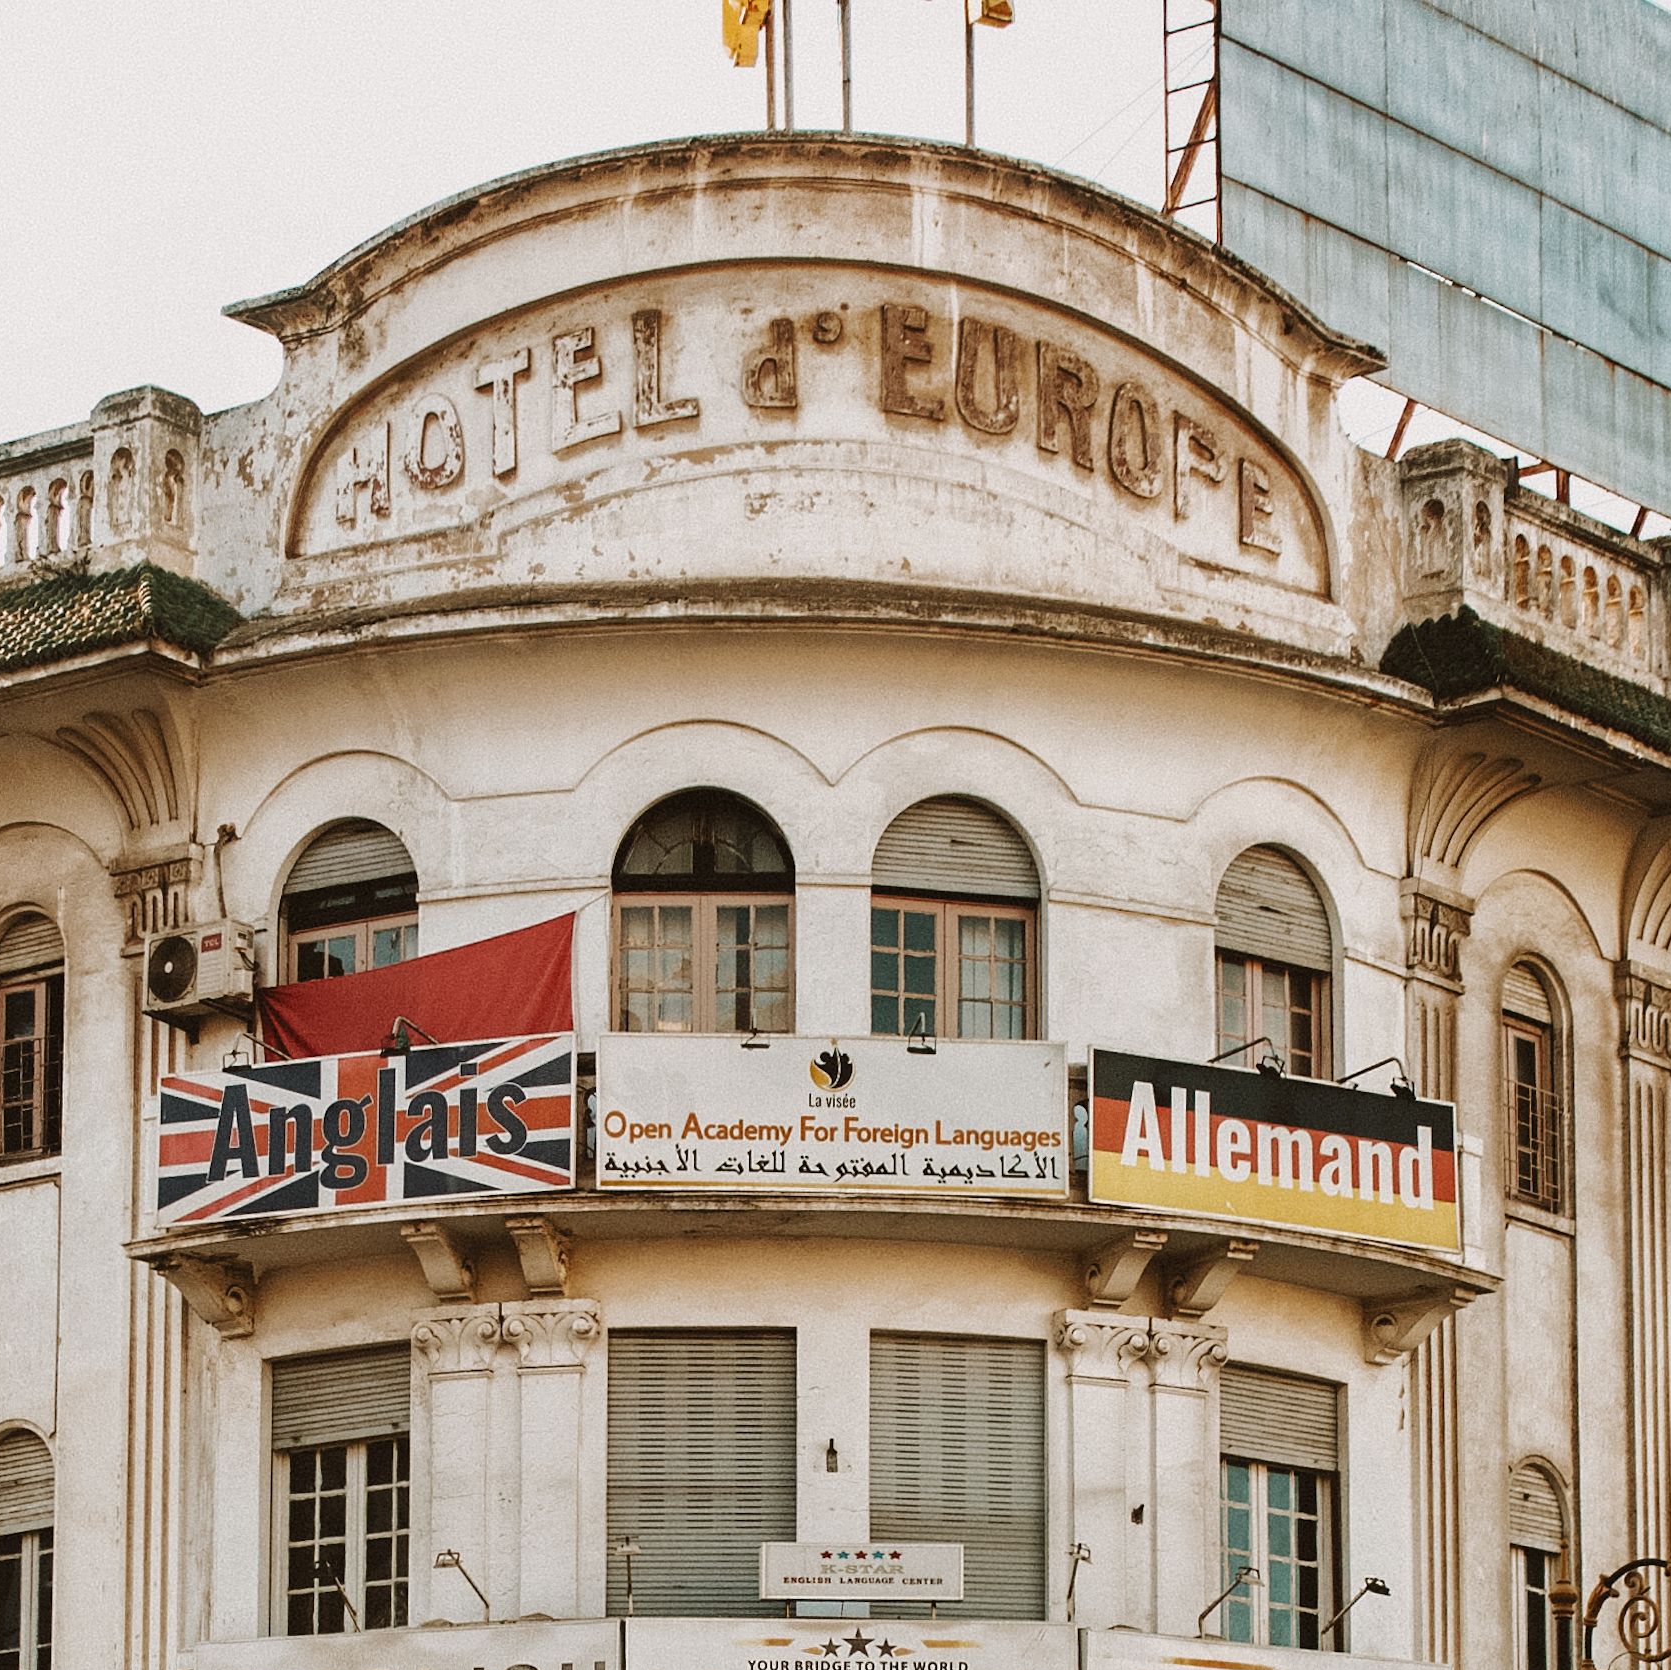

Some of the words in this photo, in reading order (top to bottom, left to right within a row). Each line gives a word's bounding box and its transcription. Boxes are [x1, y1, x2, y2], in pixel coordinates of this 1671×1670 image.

[334, 308, 700, 529] HOTEL
[808, 1093, 823, 1108] La
[825, 1092, 856, 1109] visée
[207, 1061, 529, 1190] Anglais
[604, 1110, 672, 1145] Open
[681, 1113, 793, 1146] Academy
[800, 1115, 837, 1142] For
[843, 1116, 929, 1149] Foreign
[935, 1120, 1062, 1152] Languages
[1119, 1080, 1435, 1211] Allemand
[783, 1576, 832, 1585] ENGLISH
[839, 1576, 895, 1585] LANGUAGE
[902, 1577, 944, 1586] CENTER
[820, 1563, 905, 1575] K-STAR
